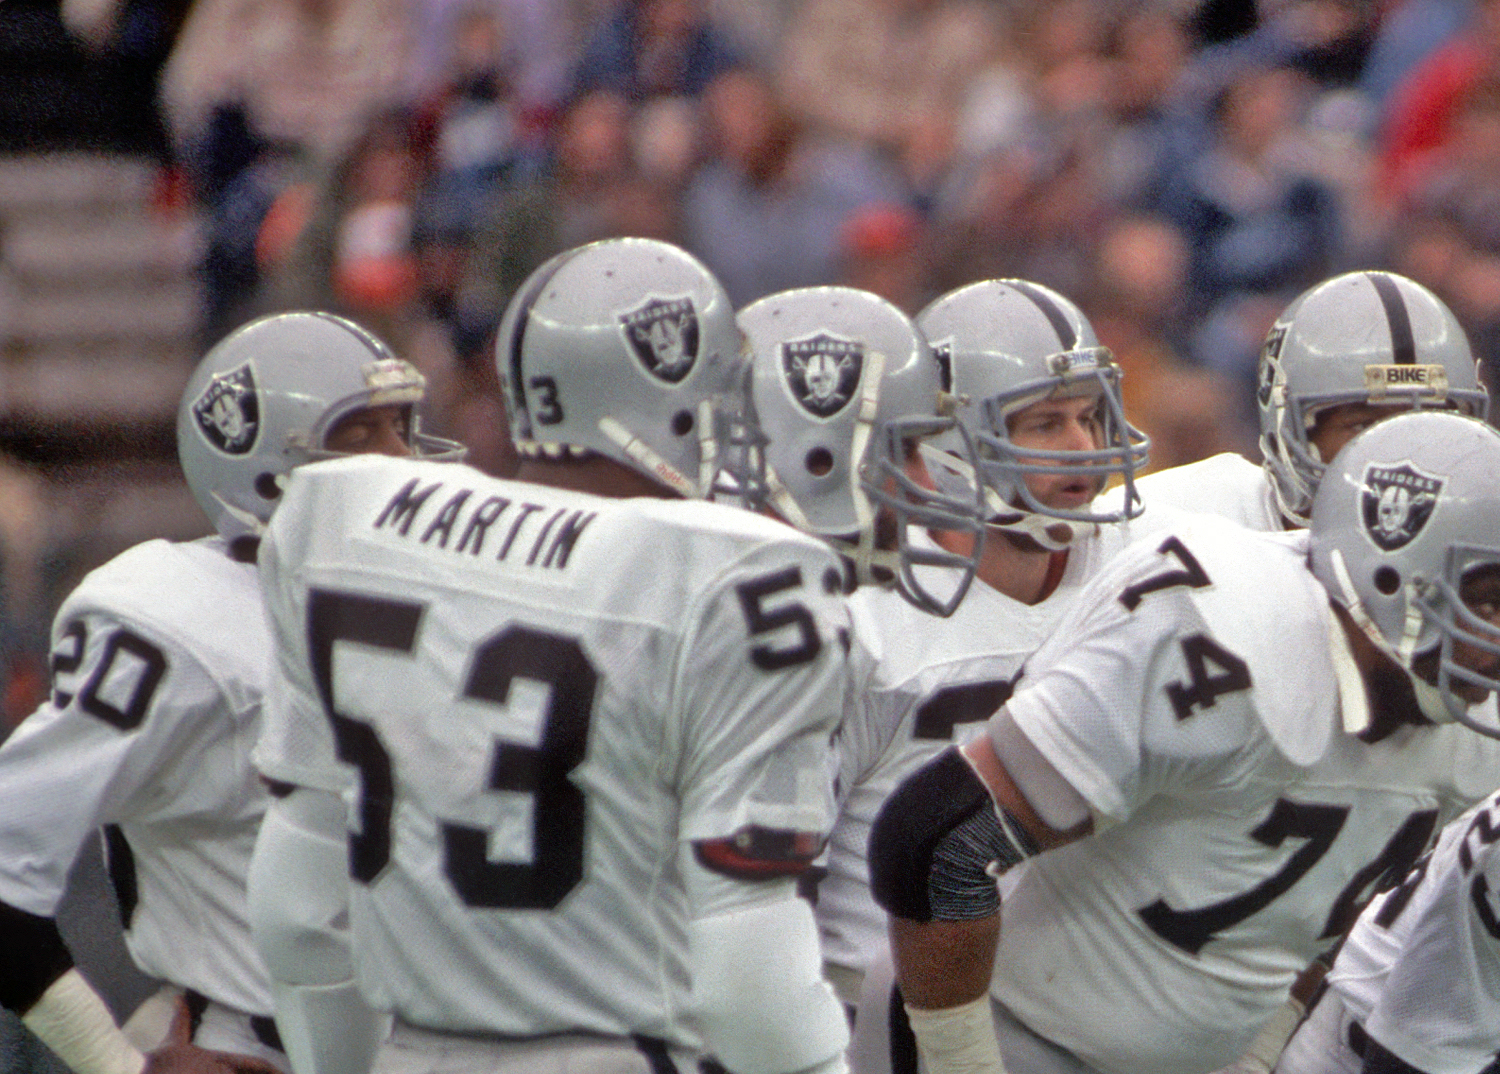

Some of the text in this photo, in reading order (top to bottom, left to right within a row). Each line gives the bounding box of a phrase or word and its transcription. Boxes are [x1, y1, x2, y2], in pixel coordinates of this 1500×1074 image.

[373, 477, 598, 570] MARTIN
[1372, 470, 1435, 490] RAIDERS
[51, 618, 167, 733] 20
[1117, 535, 1253, 722] 74
[307, 588, 604, 910] 53
